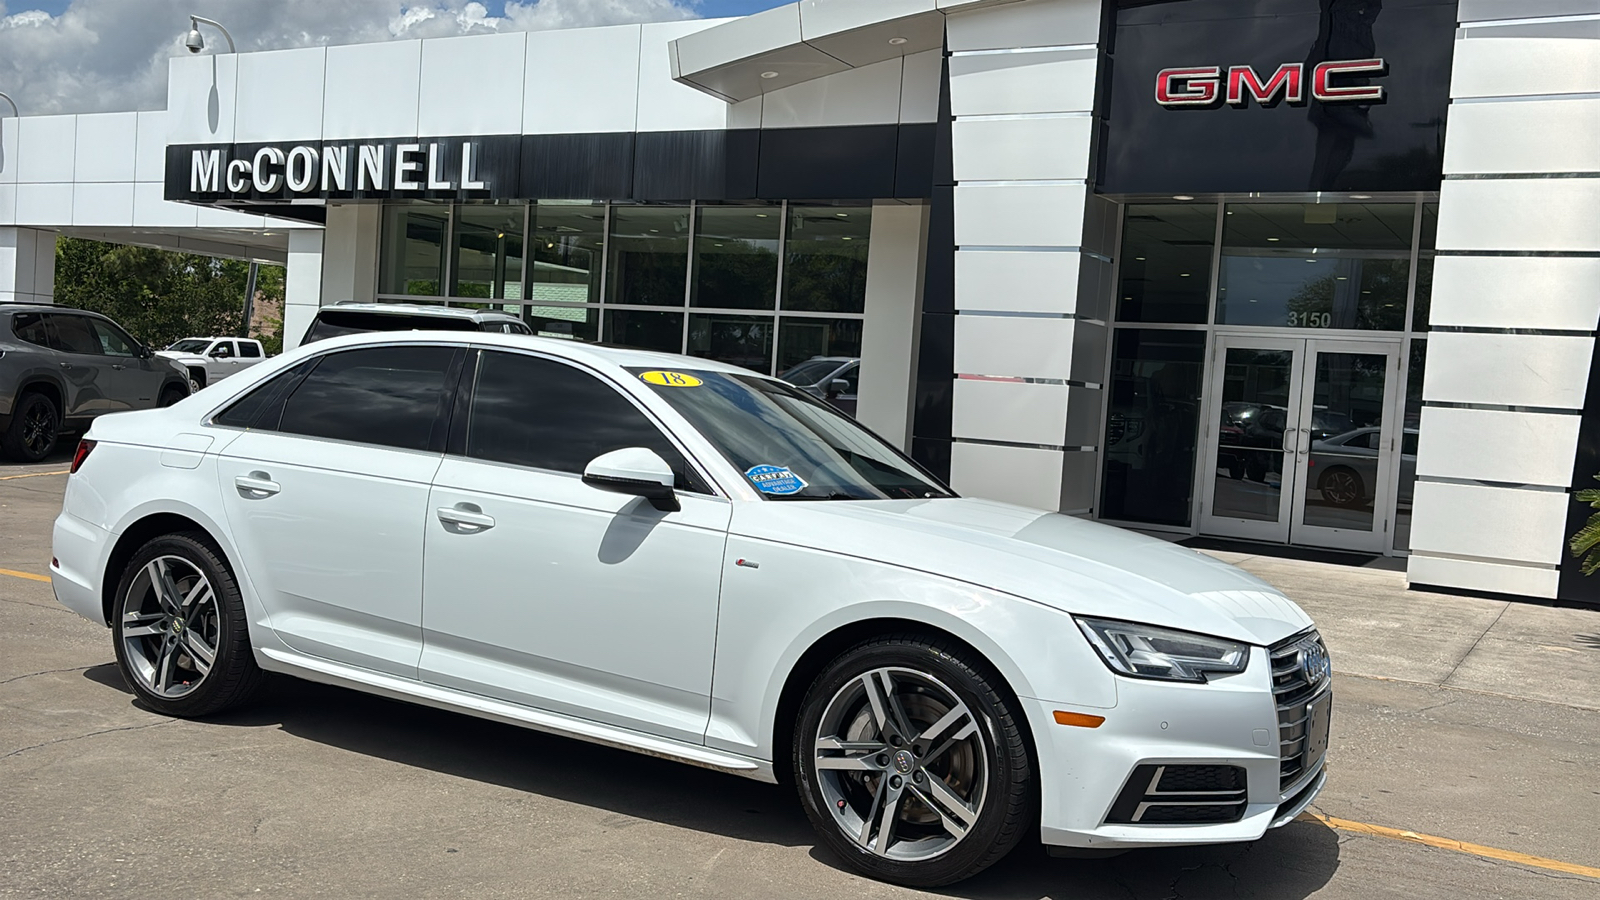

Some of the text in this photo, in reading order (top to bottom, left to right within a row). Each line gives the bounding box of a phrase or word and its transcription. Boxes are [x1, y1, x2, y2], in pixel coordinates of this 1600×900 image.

[1155, 58, 1384, 106] GMC
[190, 142, 486, 193] McCONNELL
[1287, 311, 1331, 328] 3150
[658, 372, 686, 385] 18
[761, 478, 797, 488] ADVANTAGE
[772, 484, 798, 492] DEALER
